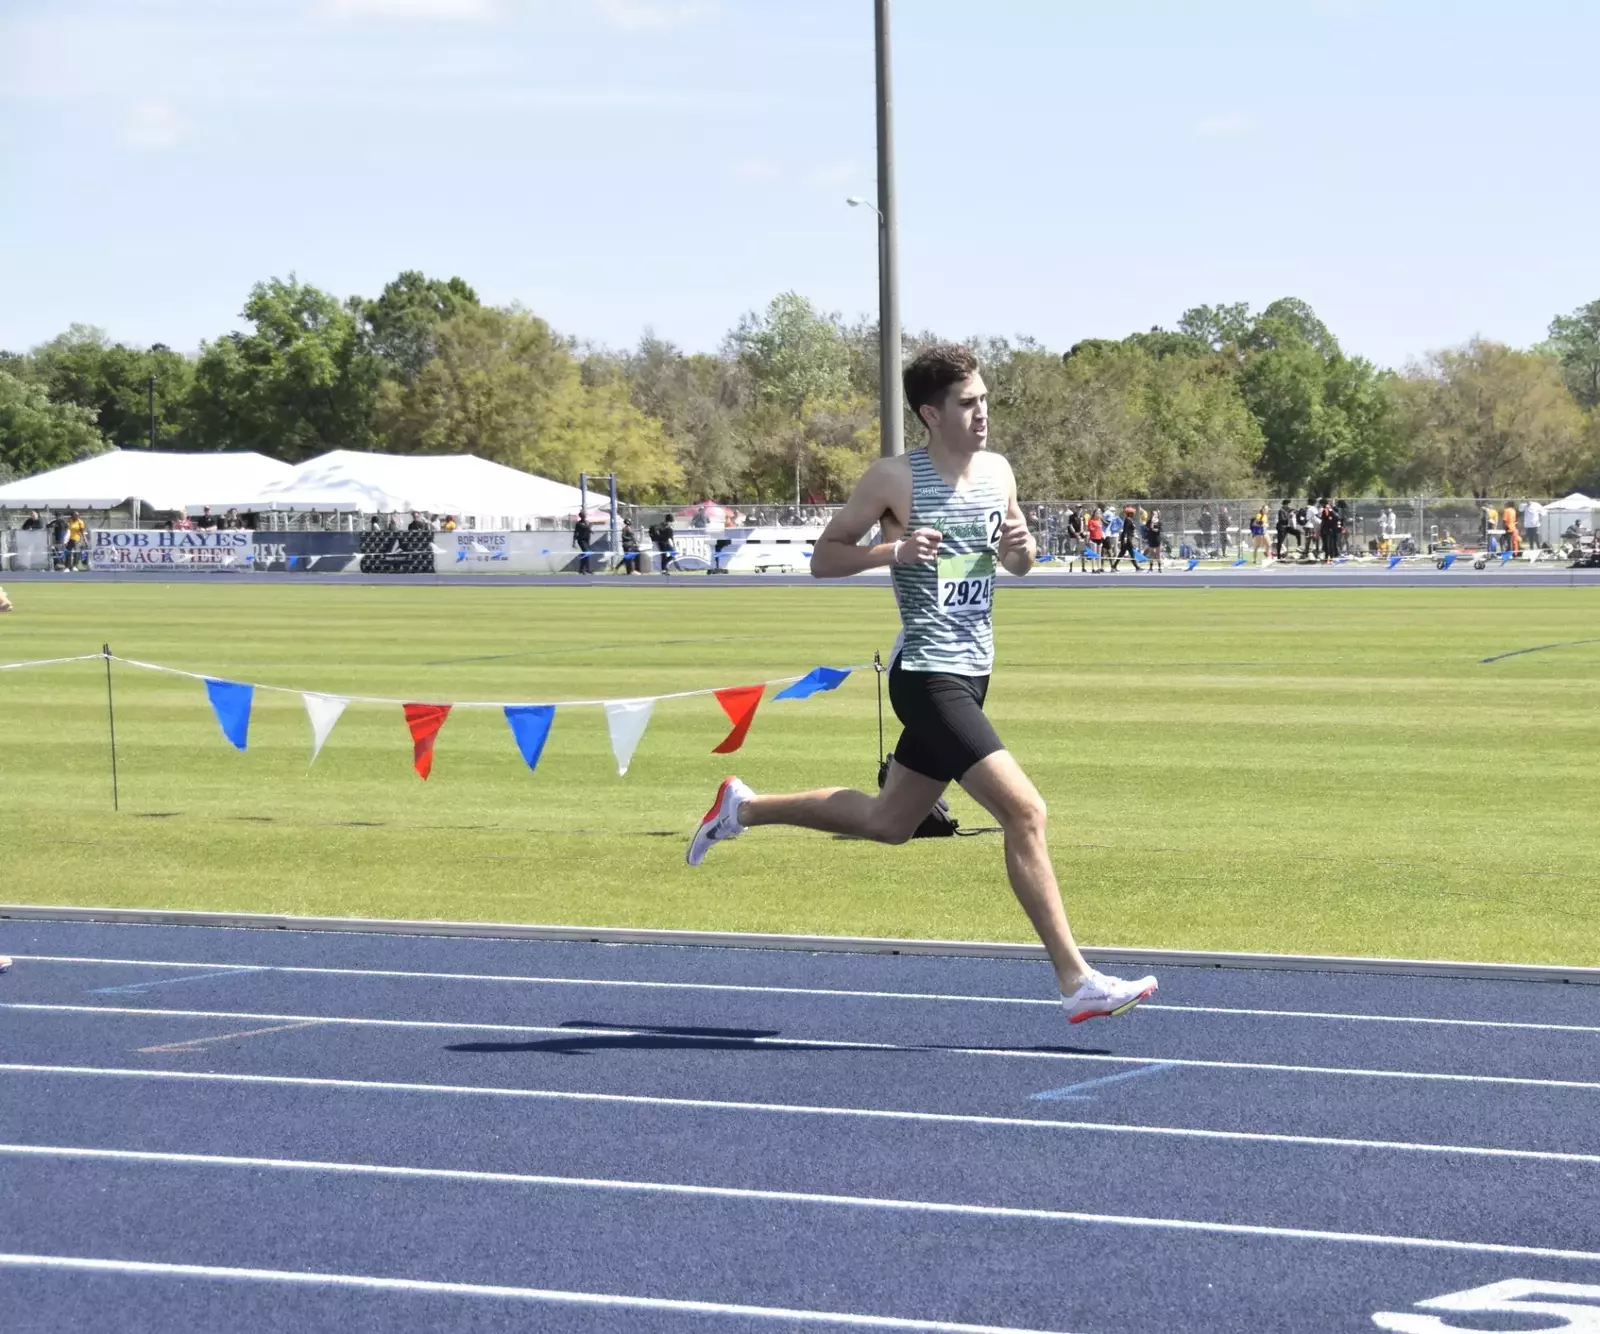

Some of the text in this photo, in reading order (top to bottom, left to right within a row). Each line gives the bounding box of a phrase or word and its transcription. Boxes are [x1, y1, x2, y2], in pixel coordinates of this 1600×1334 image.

[96, 532, 247, 547] BOB HAYES
[477, 535, 506, 545] HAYES
[944, 579, 989, 606] 2924
